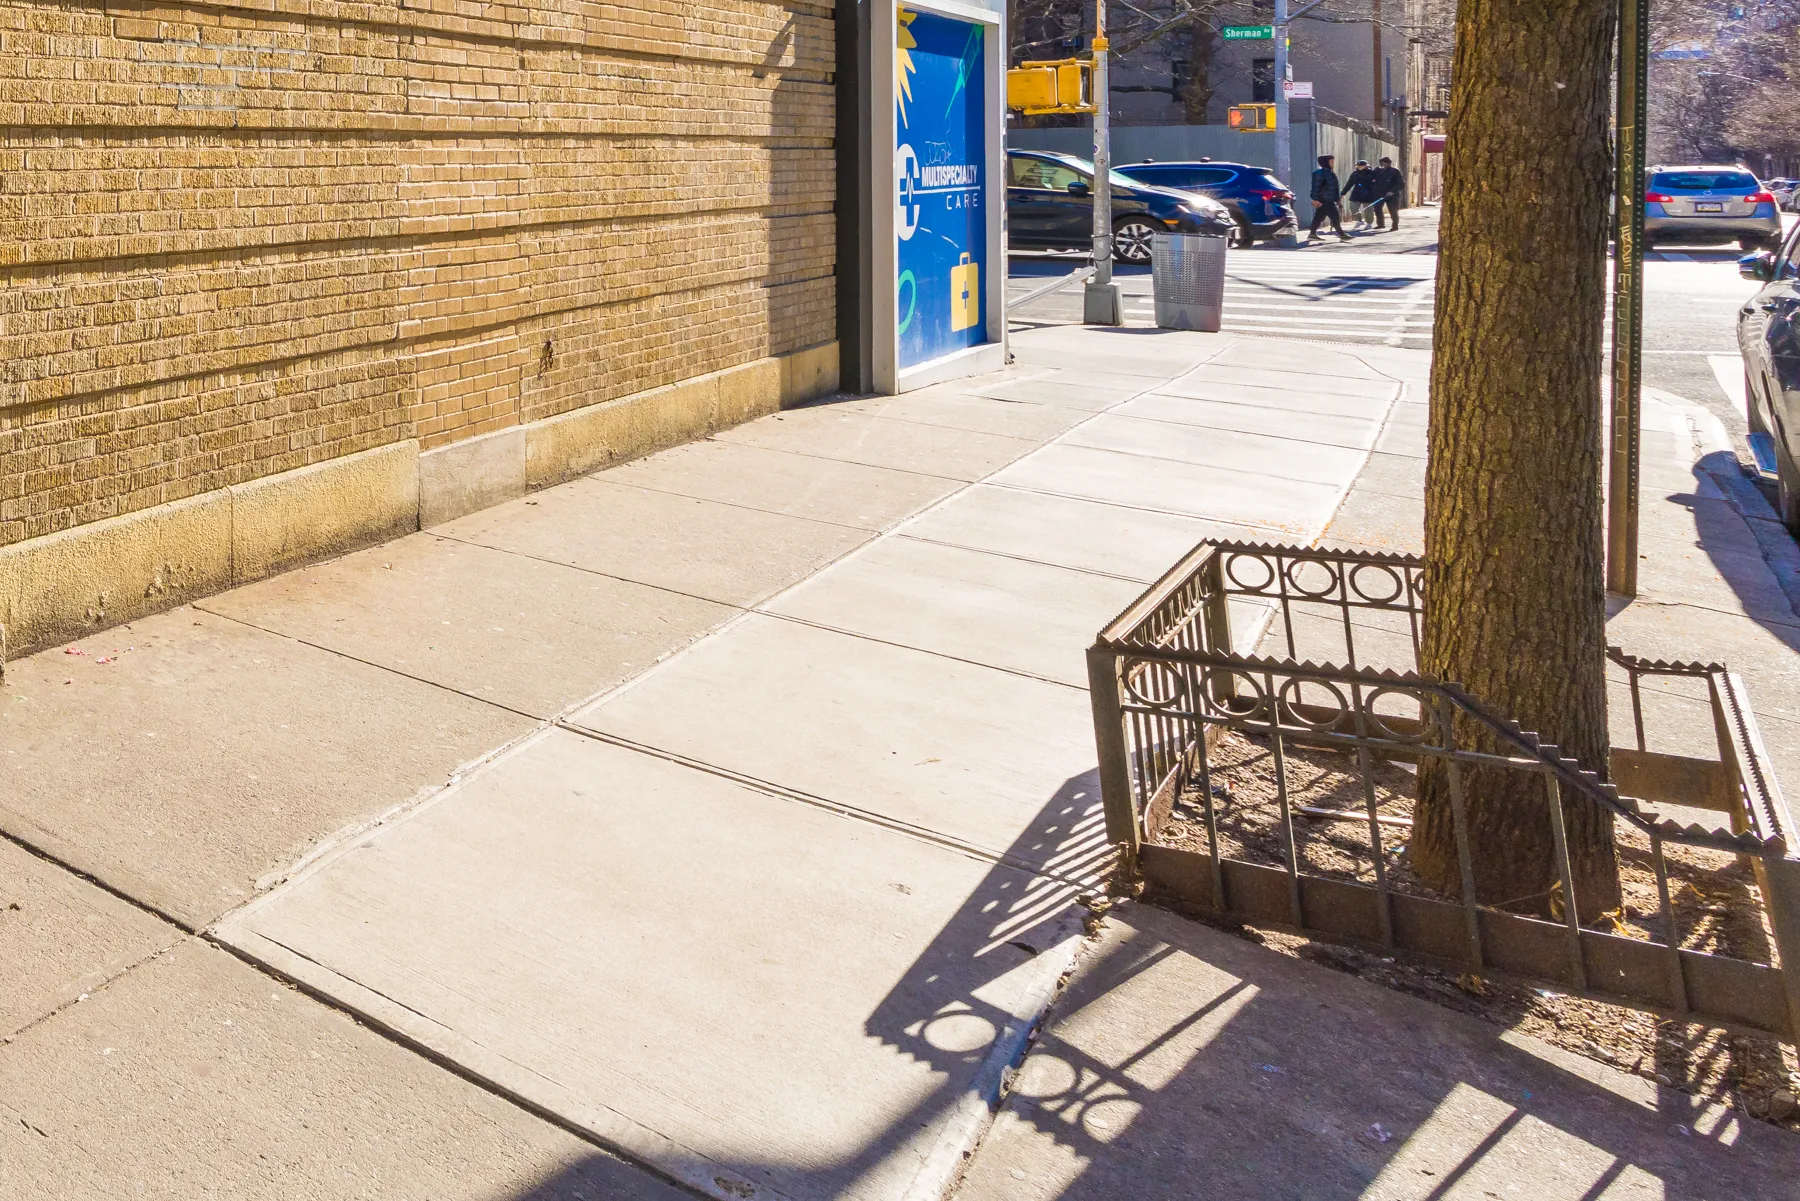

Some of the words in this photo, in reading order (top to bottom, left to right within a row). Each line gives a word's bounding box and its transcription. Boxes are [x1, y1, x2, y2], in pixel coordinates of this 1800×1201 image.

[1225, 28, 1262, 38] Sherman
[921, 165, 978, 187] MULTISPECIALTY
[946, 193, 978, 210] CARE
